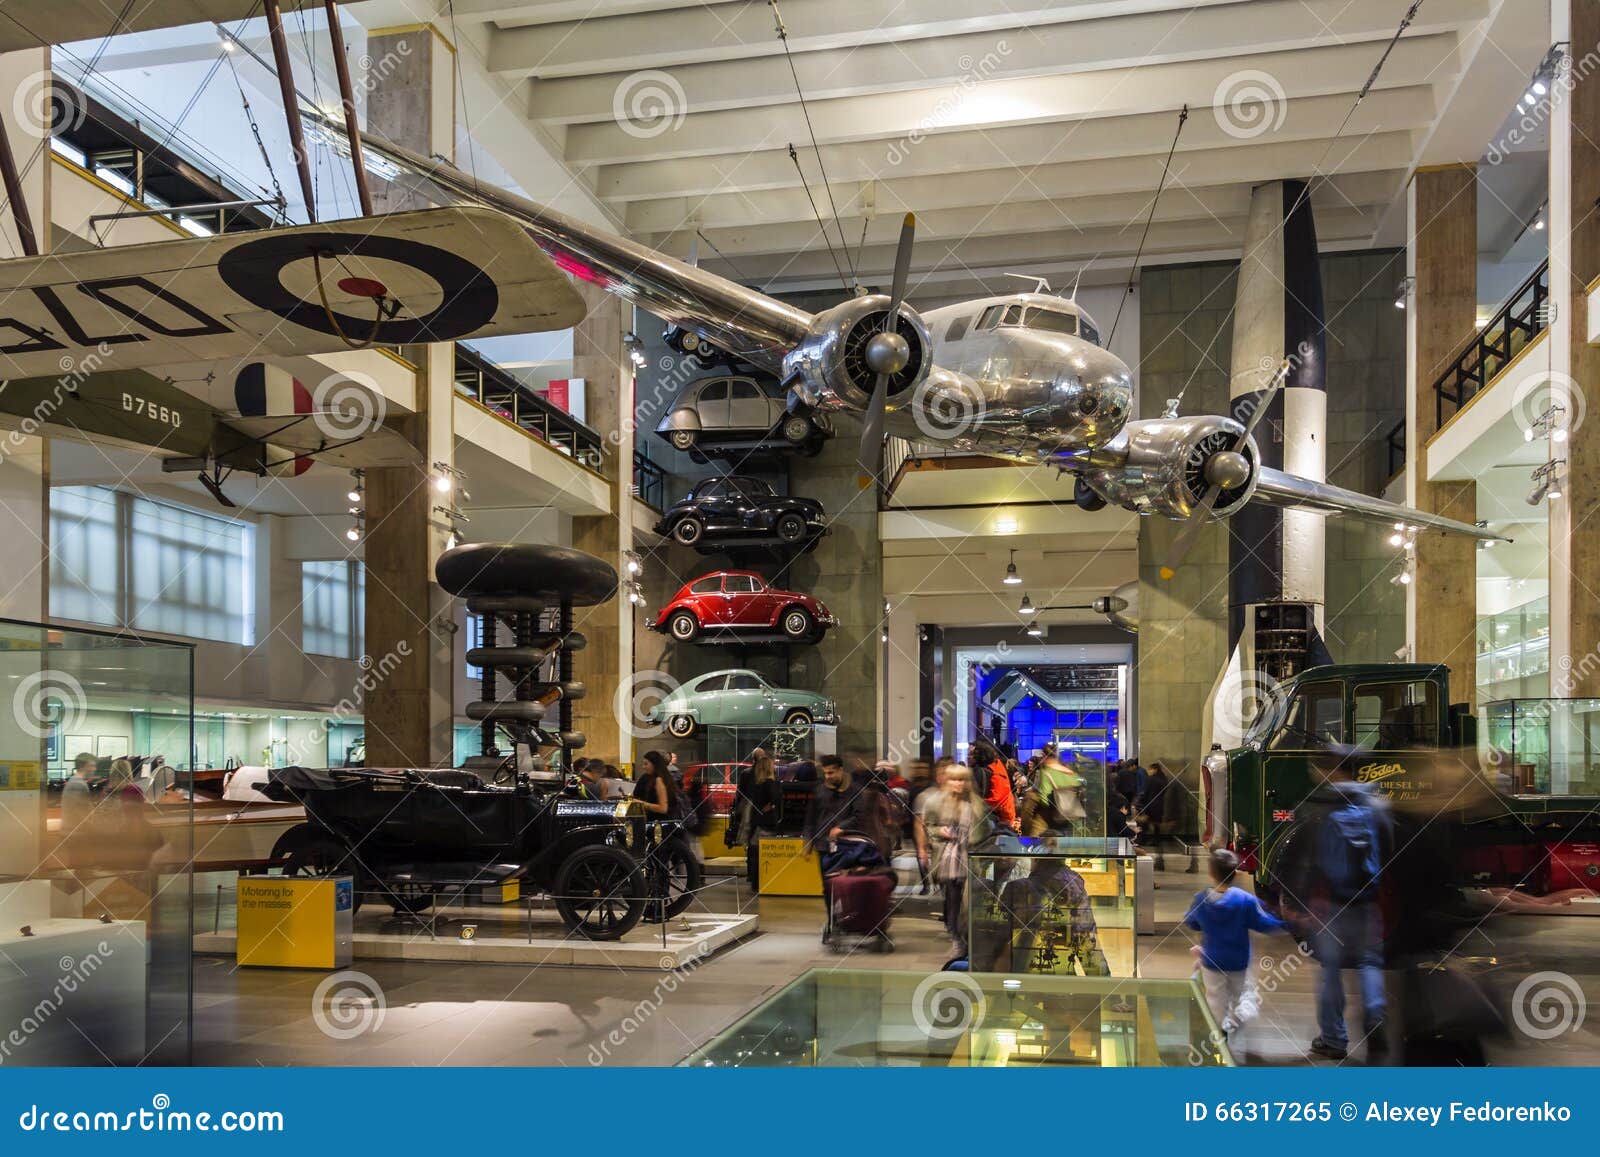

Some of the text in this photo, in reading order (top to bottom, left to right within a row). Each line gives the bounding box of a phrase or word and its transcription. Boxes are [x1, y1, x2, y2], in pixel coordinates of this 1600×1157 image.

[1357, 763, 1406, 783] Foden
[242, 887, 294, 899] Motoring for
[241, 900, 292, 909] the masses
